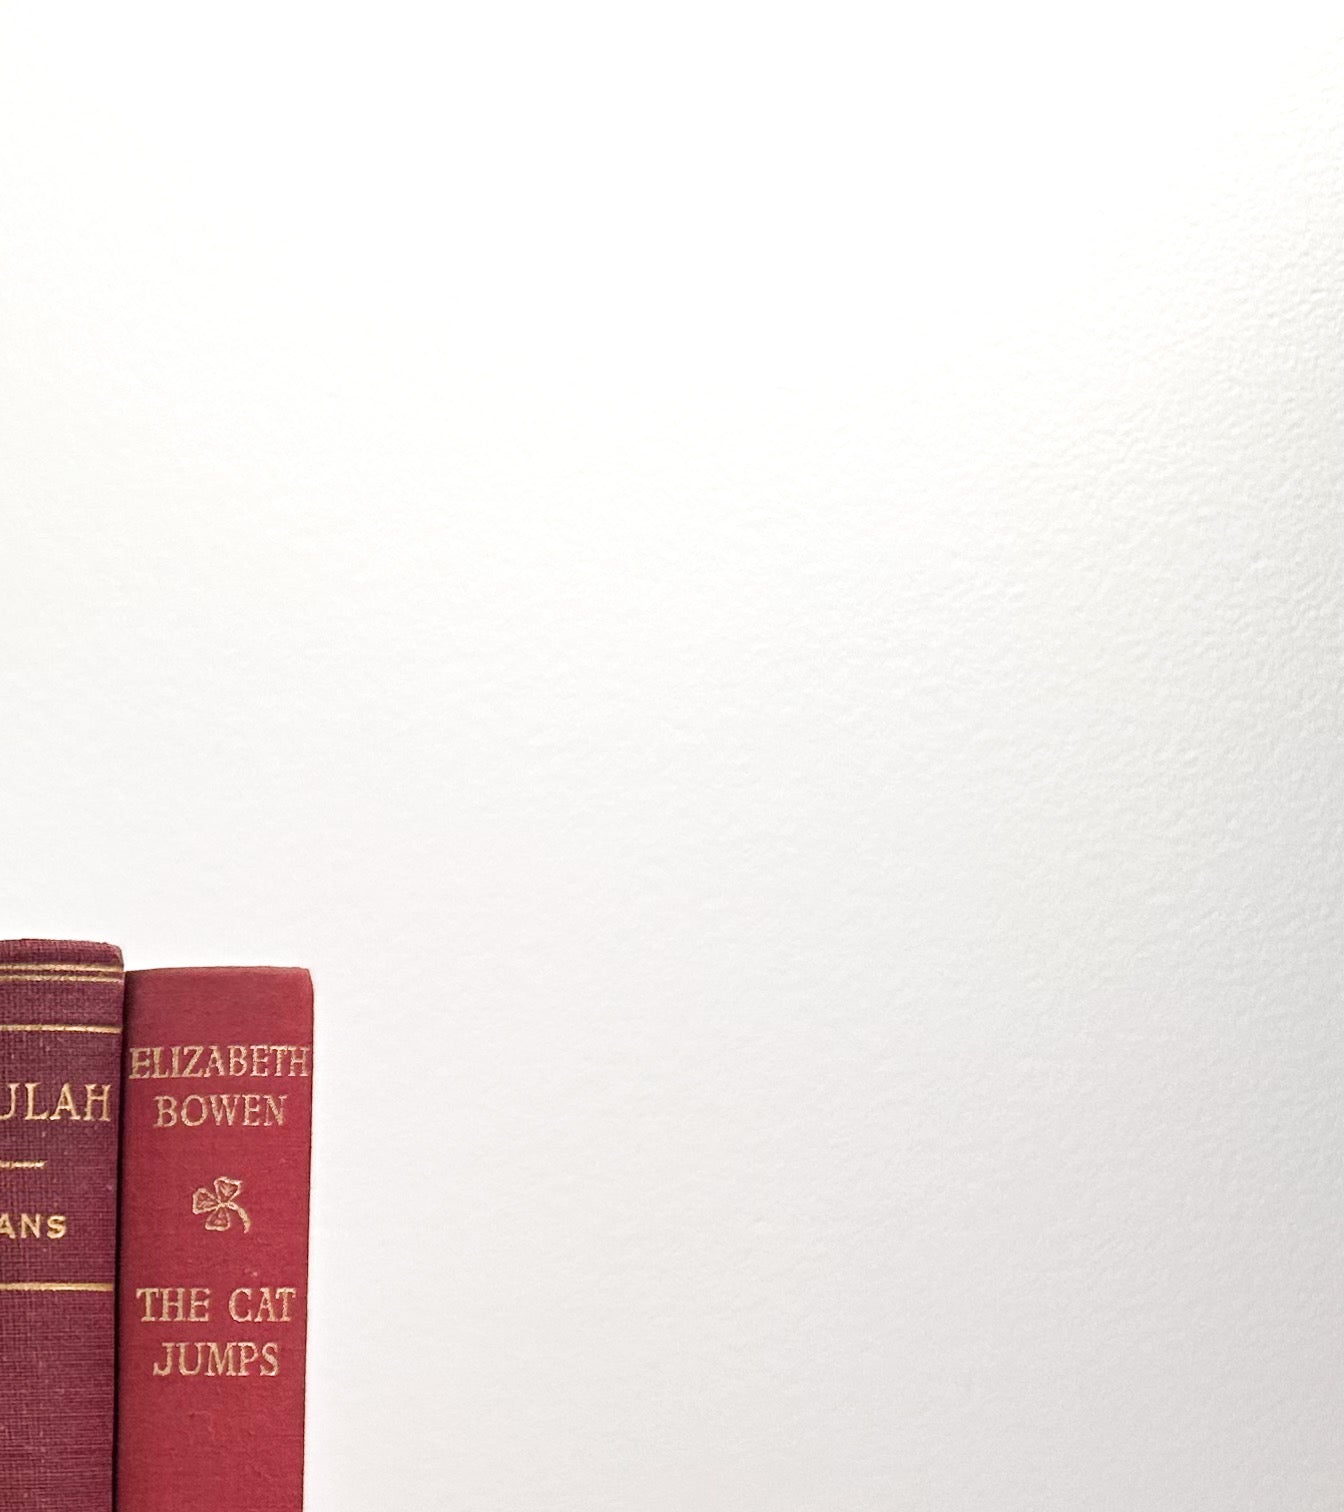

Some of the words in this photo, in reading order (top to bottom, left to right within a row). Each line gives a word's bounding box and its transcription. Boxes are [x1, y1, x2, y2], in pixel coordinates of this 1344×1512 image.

[127, 1044, 311, 1080] ELIZABETH
[152, 1093, 288, 1129] BOWEN
[135, 1287, 211, 1323] THE
[228, 1286, 297, 1323] CAT
[152, 1340, 281, 1378] JUMPS
